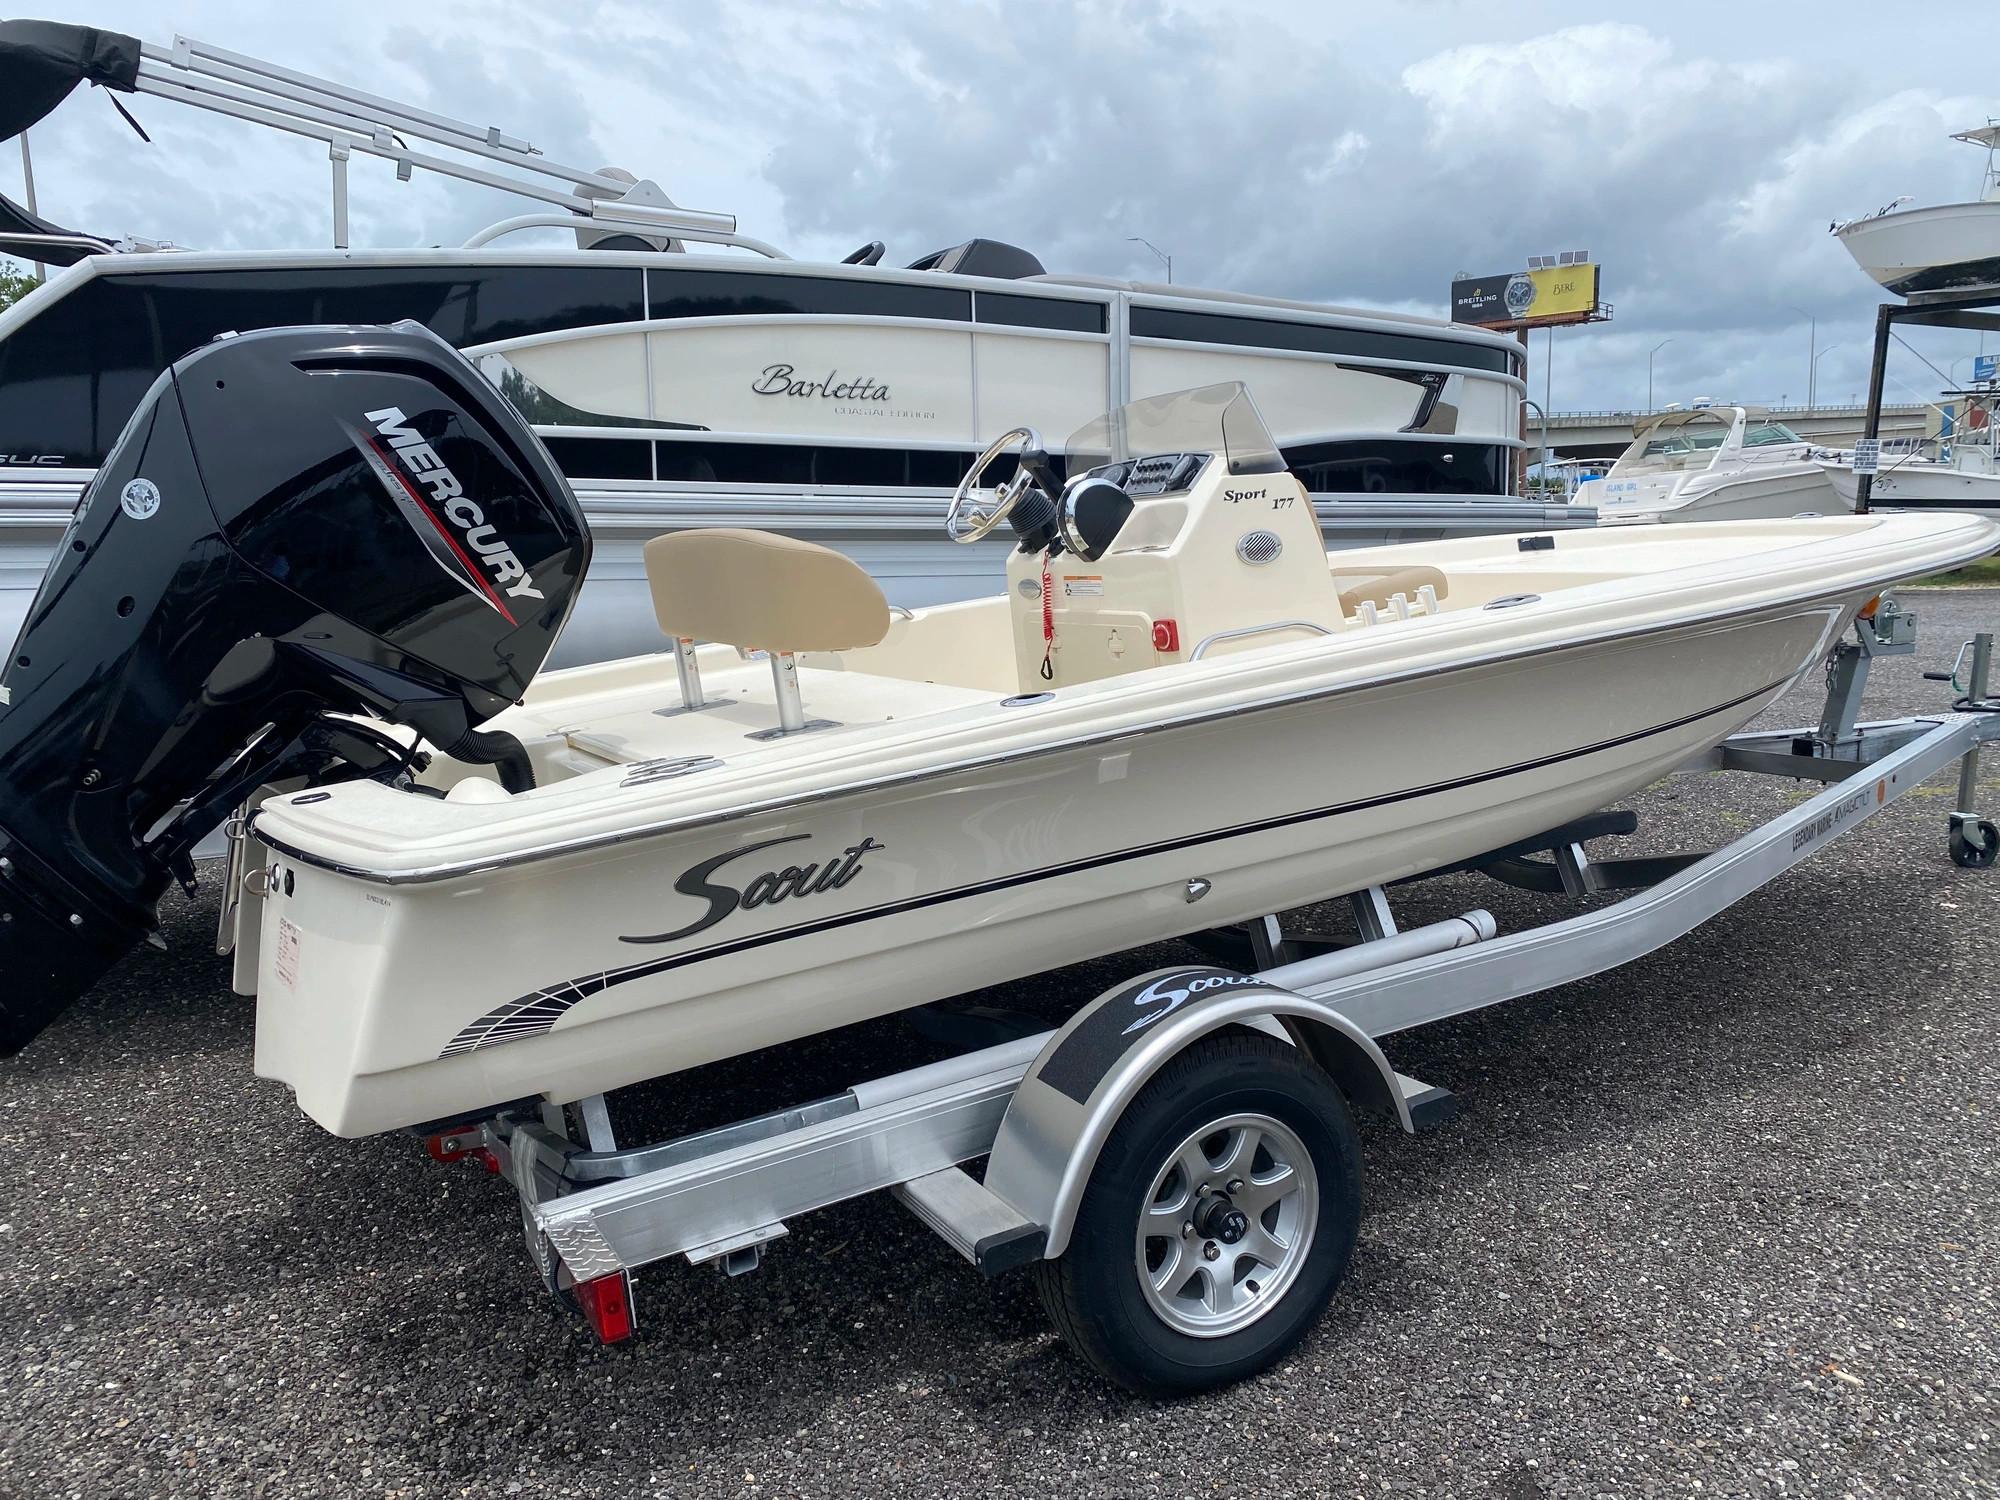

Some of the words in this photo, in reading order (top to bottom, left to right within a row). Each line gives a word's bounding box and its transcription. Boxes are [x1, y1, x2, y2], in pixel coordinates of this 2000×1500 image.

[1458, 294, 1497, 305] BREITLING
[752, 364, 890, 401] Barletta
[834, 407, 886, 418] COASTAL
[890, 409, 936, 420] EDITION
[363, 406, 545, 600] MERCURY
[1223, 488, 1267, 504] Sport
[1271, 497, 1295, 510] 177
[618, 833, 886, 943] Scout
